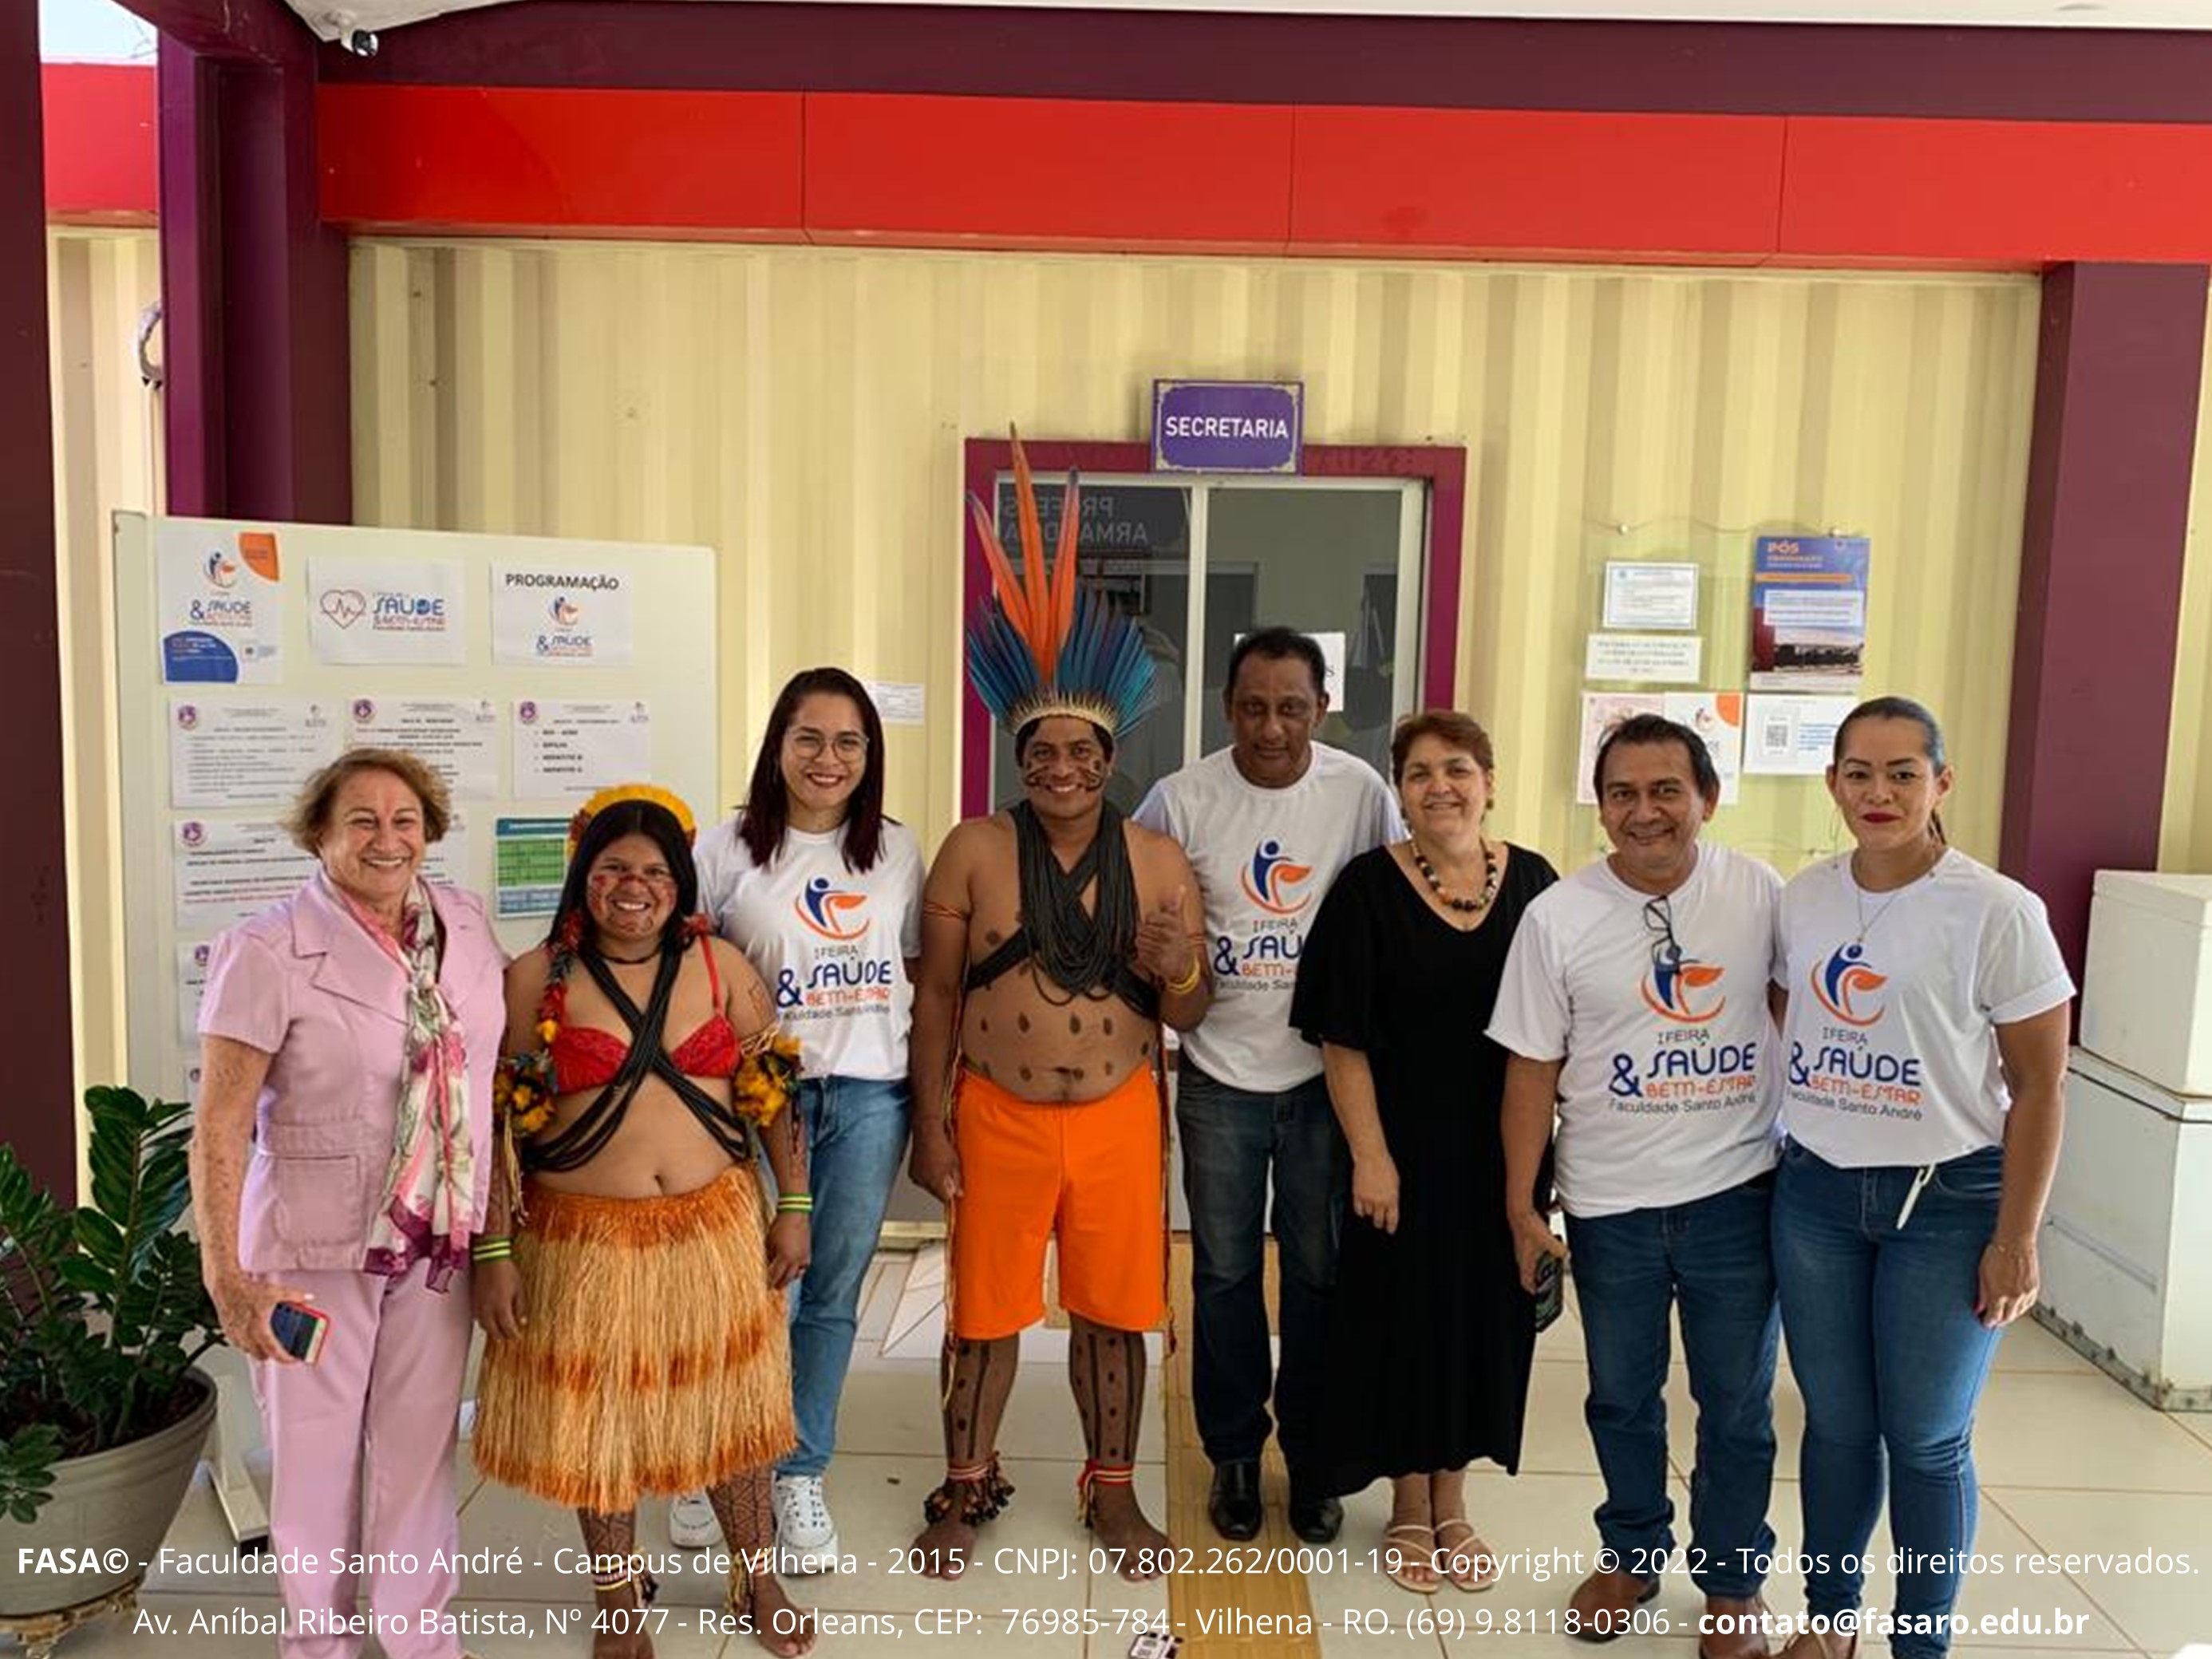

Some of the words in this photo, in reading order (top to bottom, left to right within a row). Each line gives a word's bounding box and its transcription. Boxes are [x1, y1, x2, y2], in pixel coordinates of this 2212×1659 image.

[1165, 416, 1289, 438] SECRETARIA
[505, 573, 619, 591] PROGRAMAÇÃO
[1260, 918, 1298, 931] FEIRA
[820, 945, 859, 958] FEIRA
[1214, 936, 1240, 976] &
[1242, 929, 1303, 959] SAÚ
[776, 969, 804, 1008] &
[807, 956, 892, 989] SAÚDE
[1665, 1029, 1711, 1044] FEIRA
[1831, 1028, 1869, 1046] FEIRA
[1609, 1052, 1644, 1098] &
[1646, 1041, 1758, 1079] SAÚDE
[1789, 1041, 1811, 1087] &
[1814, 1045, 1922, 1086] SAÚDE
[1645, 1075, 1757, 1099] BEM-ESTAR
[1811, 1075, 1922, 1106] BEM-ESTAR
[1609, 1098, 1679, 1114] Faculdade
[1682, 1098, 1721, 1113] Santo
[1837, 1096, 1878, 1116] Santo
[1878, 1103, 1923, 1123] André
